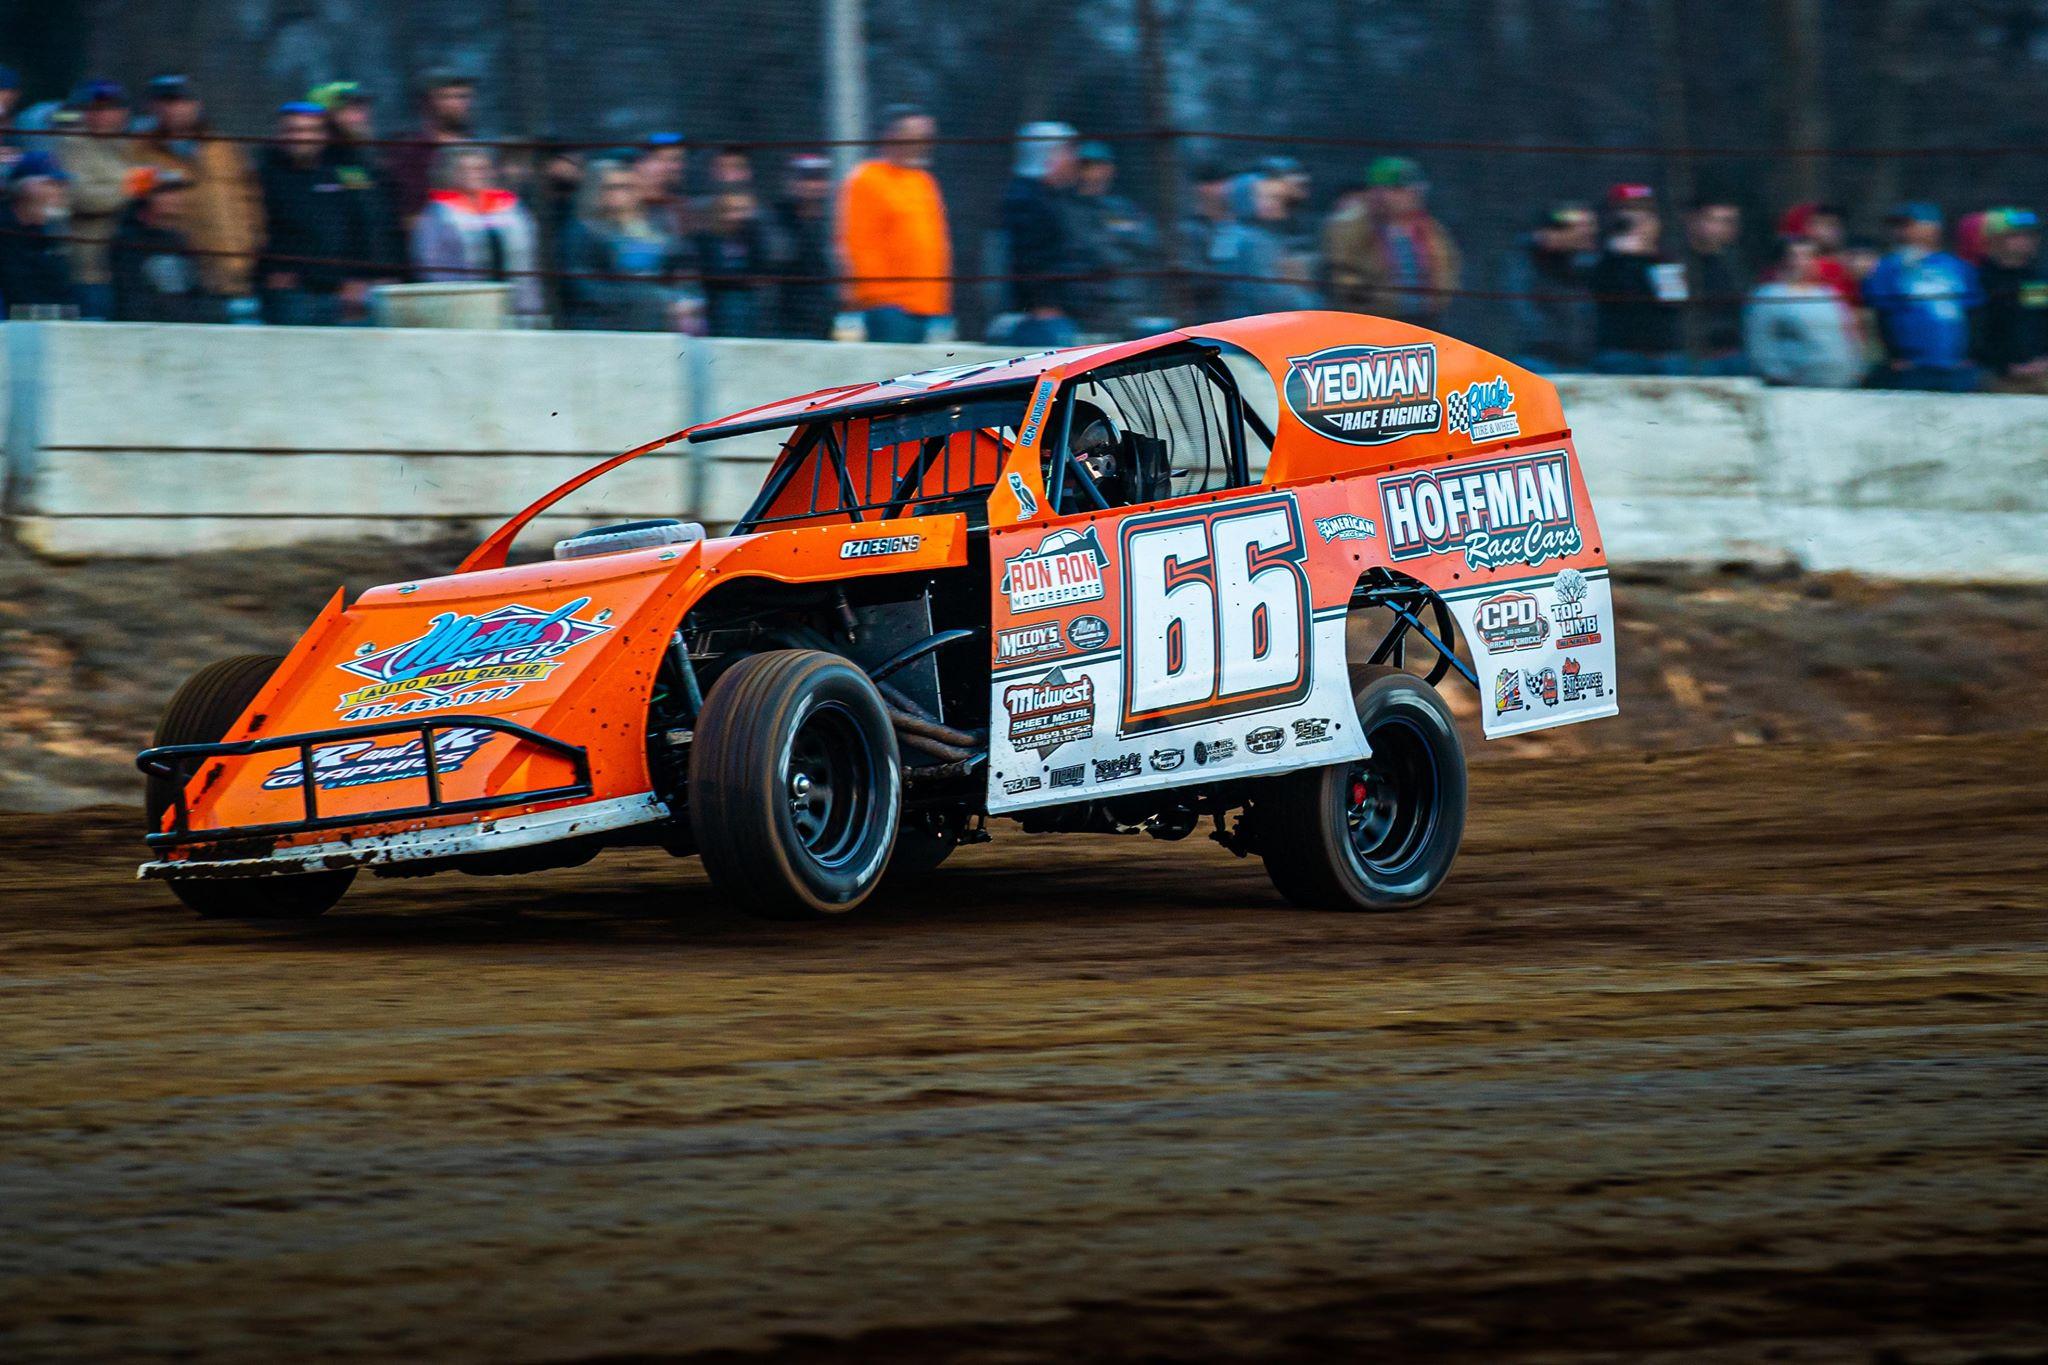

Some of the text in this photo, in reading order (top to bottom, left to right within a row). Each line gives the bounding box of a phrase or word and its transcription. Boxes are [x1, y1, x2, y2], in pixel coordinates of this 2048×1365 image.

[1301, 355, 1429, 405] YEOMAN
[1342, 404, 1438, 431] RACE ENGINES
[1021, 425, 1037, 446] BEN
[1385, 462, 1567, 546] HOFFMAN
[1319, 516, 1375, 538] AMERICAN
[1465, 521, 1577, 561] Race Cars
[1011, 553, 1098, 593] RON RON
[1013, 583, 1100, 606] MOTORSPORTS
[1130, 509, 1299, 713] 66
[1552, 601, 1581, 621] TOP
[1481, 599, 1537, 630] CPD
[1561, 615, 1598, 637] LIMB
[387, 598, 591, 683] Metal
[446, 643, 573, 672] MAGIC
[366, 663, 542, 700] AUTO HAIL REPAIR
[1006, 679, 1091, 715] Midwest
[348, 683, 522, 721] 417.459.1777
[1013, 715, 1051, 731] SHEET
